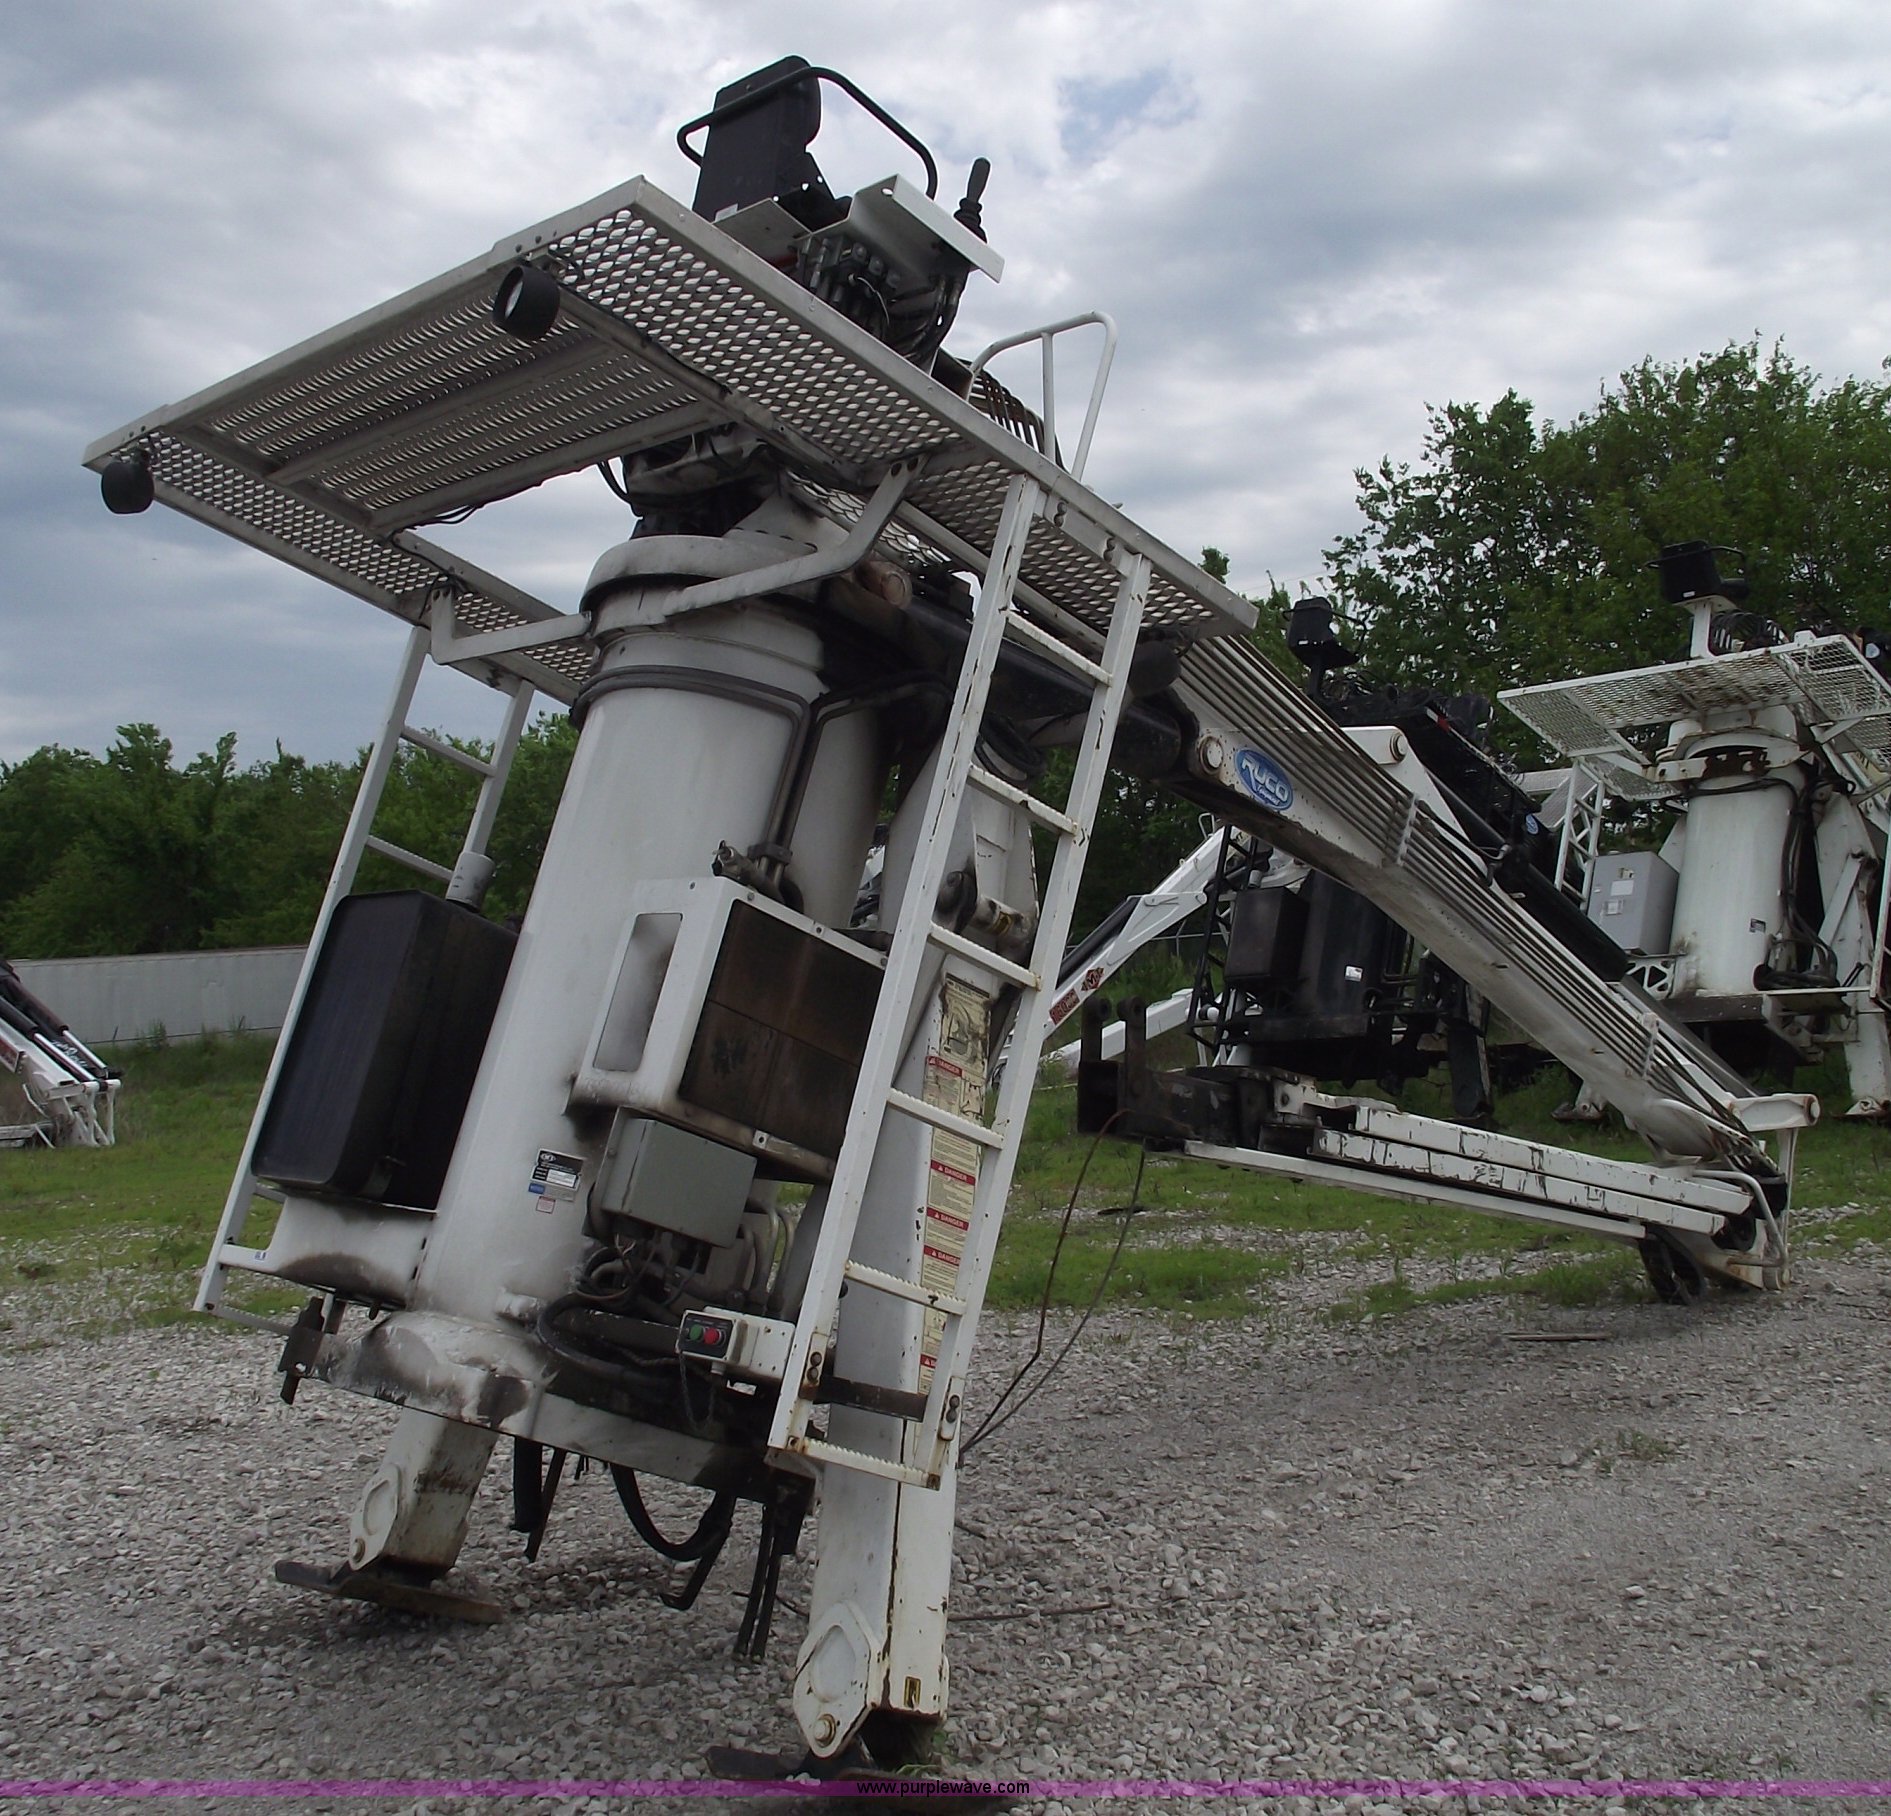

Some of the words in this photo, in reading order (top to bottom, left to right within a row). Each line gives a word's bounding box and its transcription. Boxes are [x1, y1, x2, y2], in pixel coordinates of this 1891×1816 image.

[1242, 755, 1289, 802] RUCO
[944, 1166, 967, 1181] DANGER
[940, 1213, 964, 1228] DANGER
